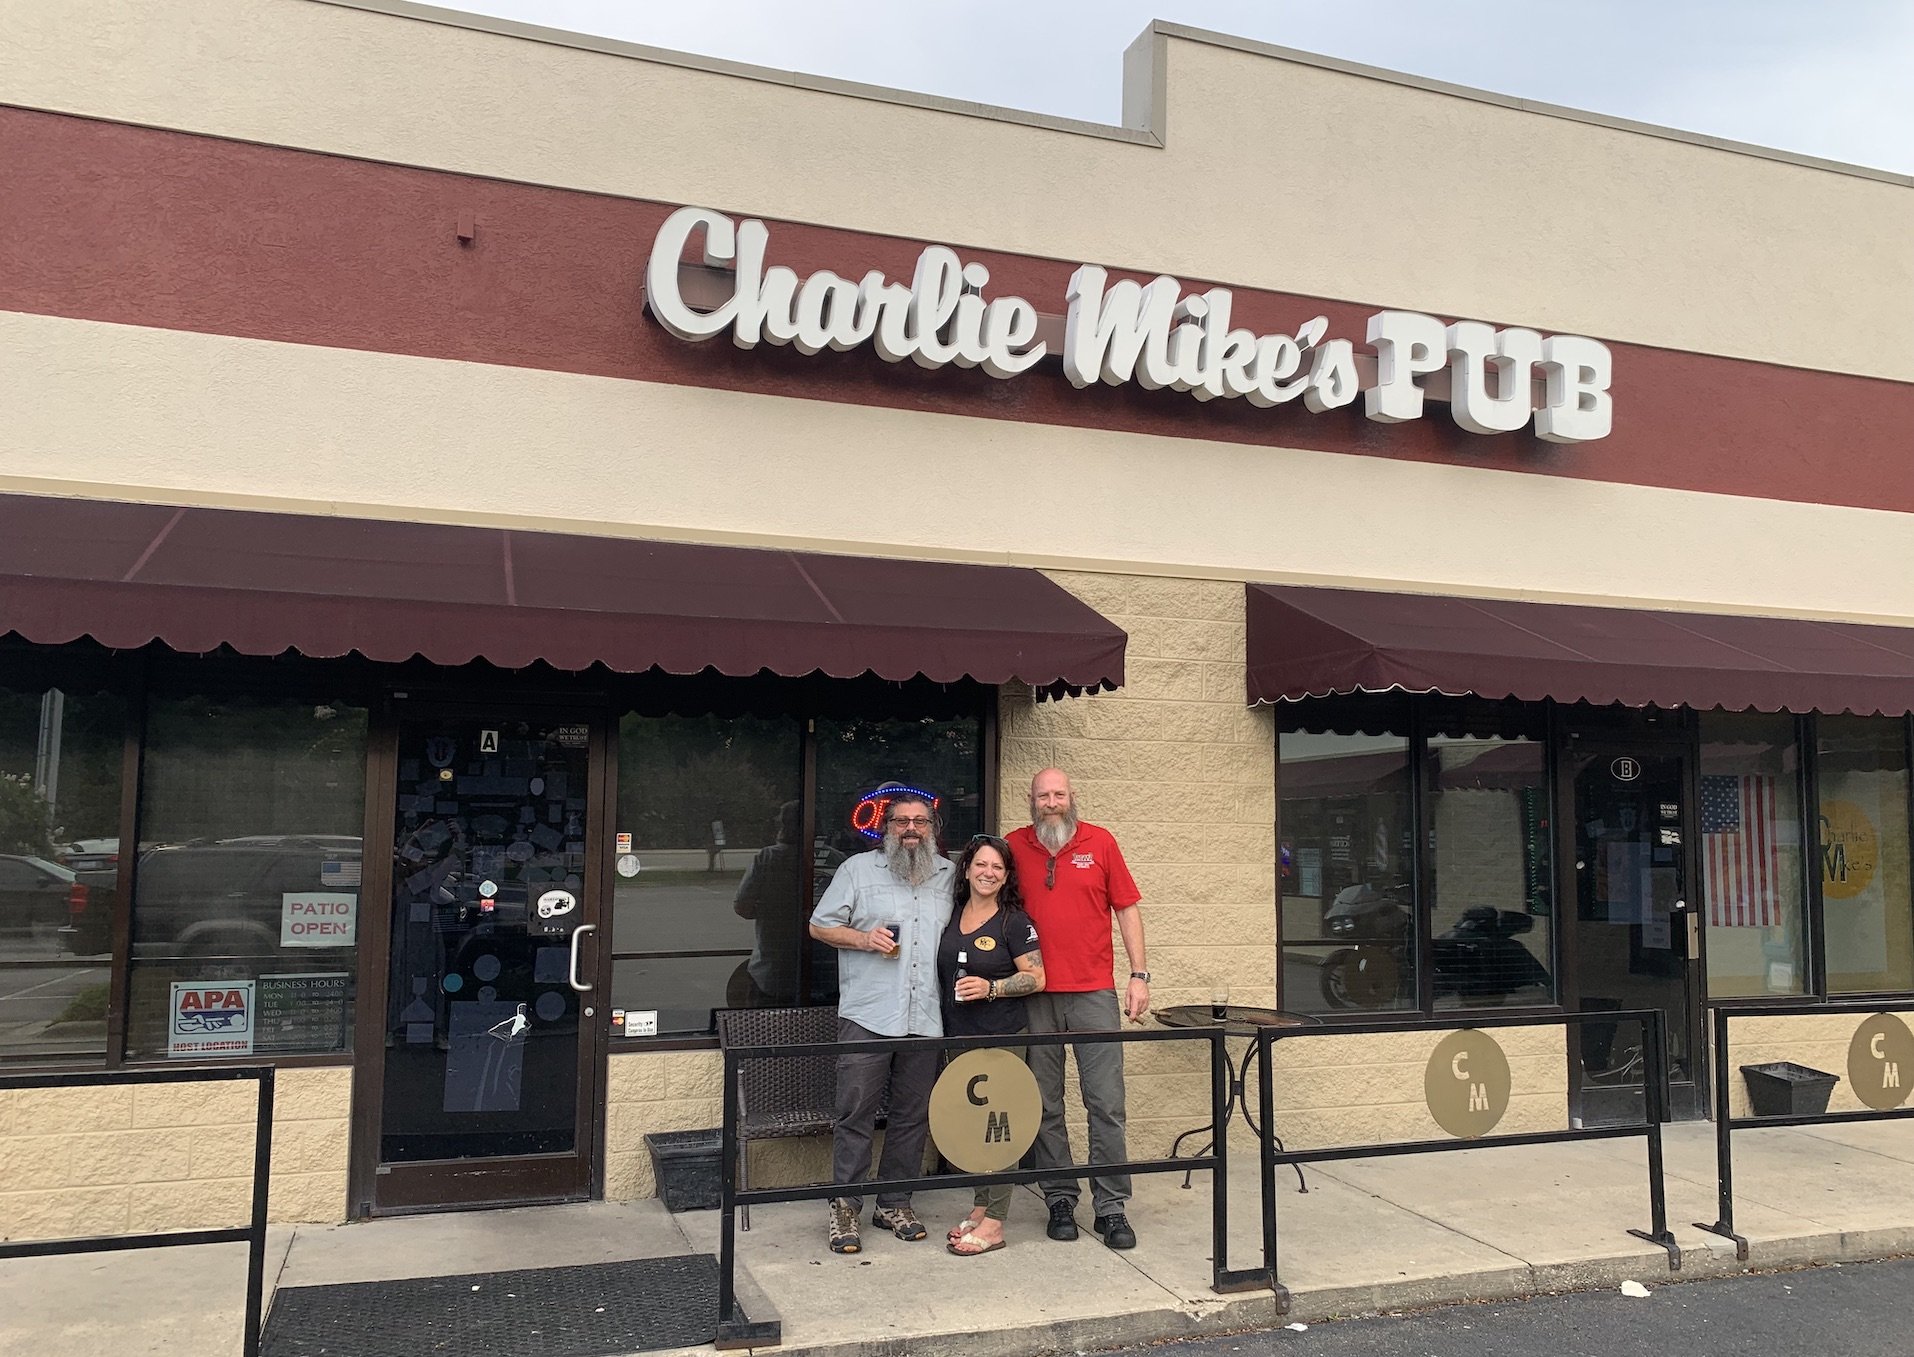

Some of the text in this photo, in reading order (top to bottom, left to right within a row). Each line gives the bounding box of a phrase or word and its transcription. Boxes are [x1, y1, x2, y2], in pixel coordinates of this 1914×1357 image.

[645, 205, 1613, 443] Charlie Mike's PUB
[559, 727, 588, 735] IN GOD
[482, 732, 496, 750] A
[290, 903, 350, 915] PATIO
[290, 922, 347, 935] OPEN
[263, 979, 345, 990] BUSINESS HOURS
[179, 991, 245, 1011] APA
[263, 992, 284, 1000] MON
[263, 1009, 282, 1017] WED
[172, 1040, 249, 1052] HOST LOCATION
[1870, 1033, 1885, 1059] C
[1452, 1051, 1470, 1080] C
[1882, 1062, 1900, 1088] M
[966, 1073, 989, 1107] C
[1468, 1083, 1489, 1112] M
[985, 1111, 1011, 1143] M
